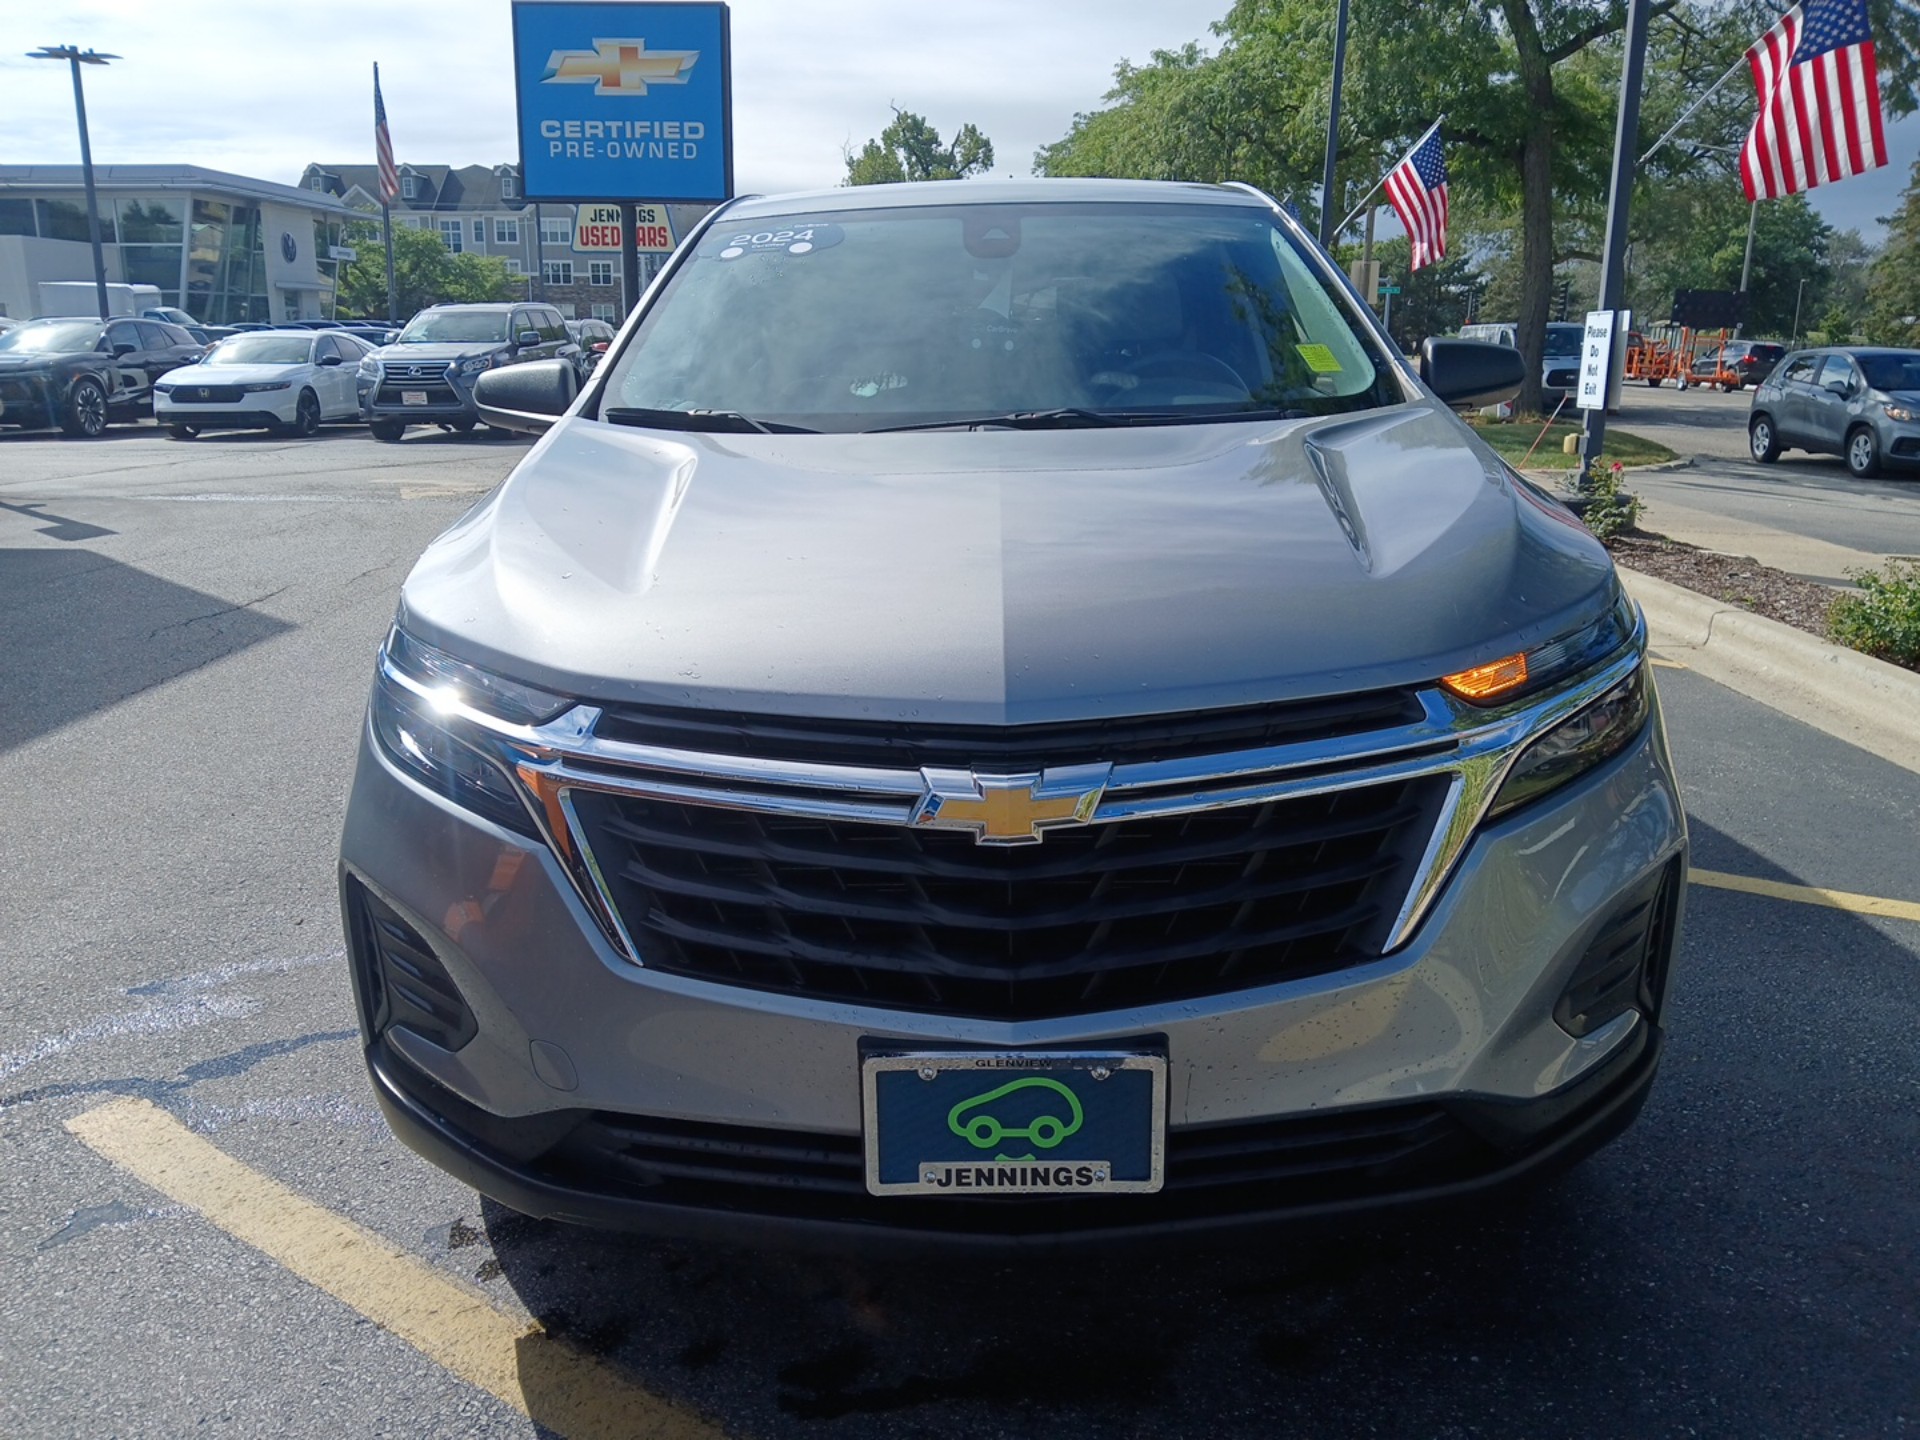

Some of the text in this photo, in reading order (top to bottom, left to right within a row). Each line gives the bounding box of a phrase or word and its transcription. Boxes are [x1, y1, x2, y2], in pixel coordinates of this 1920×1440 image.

[540, 120, 705, 139] CERTIFIED
[550, 141, 697, 159] PRE-OWNED
[590, 209, 655, 223] JENNGS
[580, 226, 668, 247] USED ARS
[730, 229, 814, 246] 2024
[1587, 326, 1608, 338] Please
[1590, 345, 1599, 357] Do
[1587, 364, 1598, 376] Not
[1584, 383, 1597, 395] Exit
[975, 1059, 1051, 1067] GLENVIEW
[937, 1166, 1093, 1187] JENNINGS
